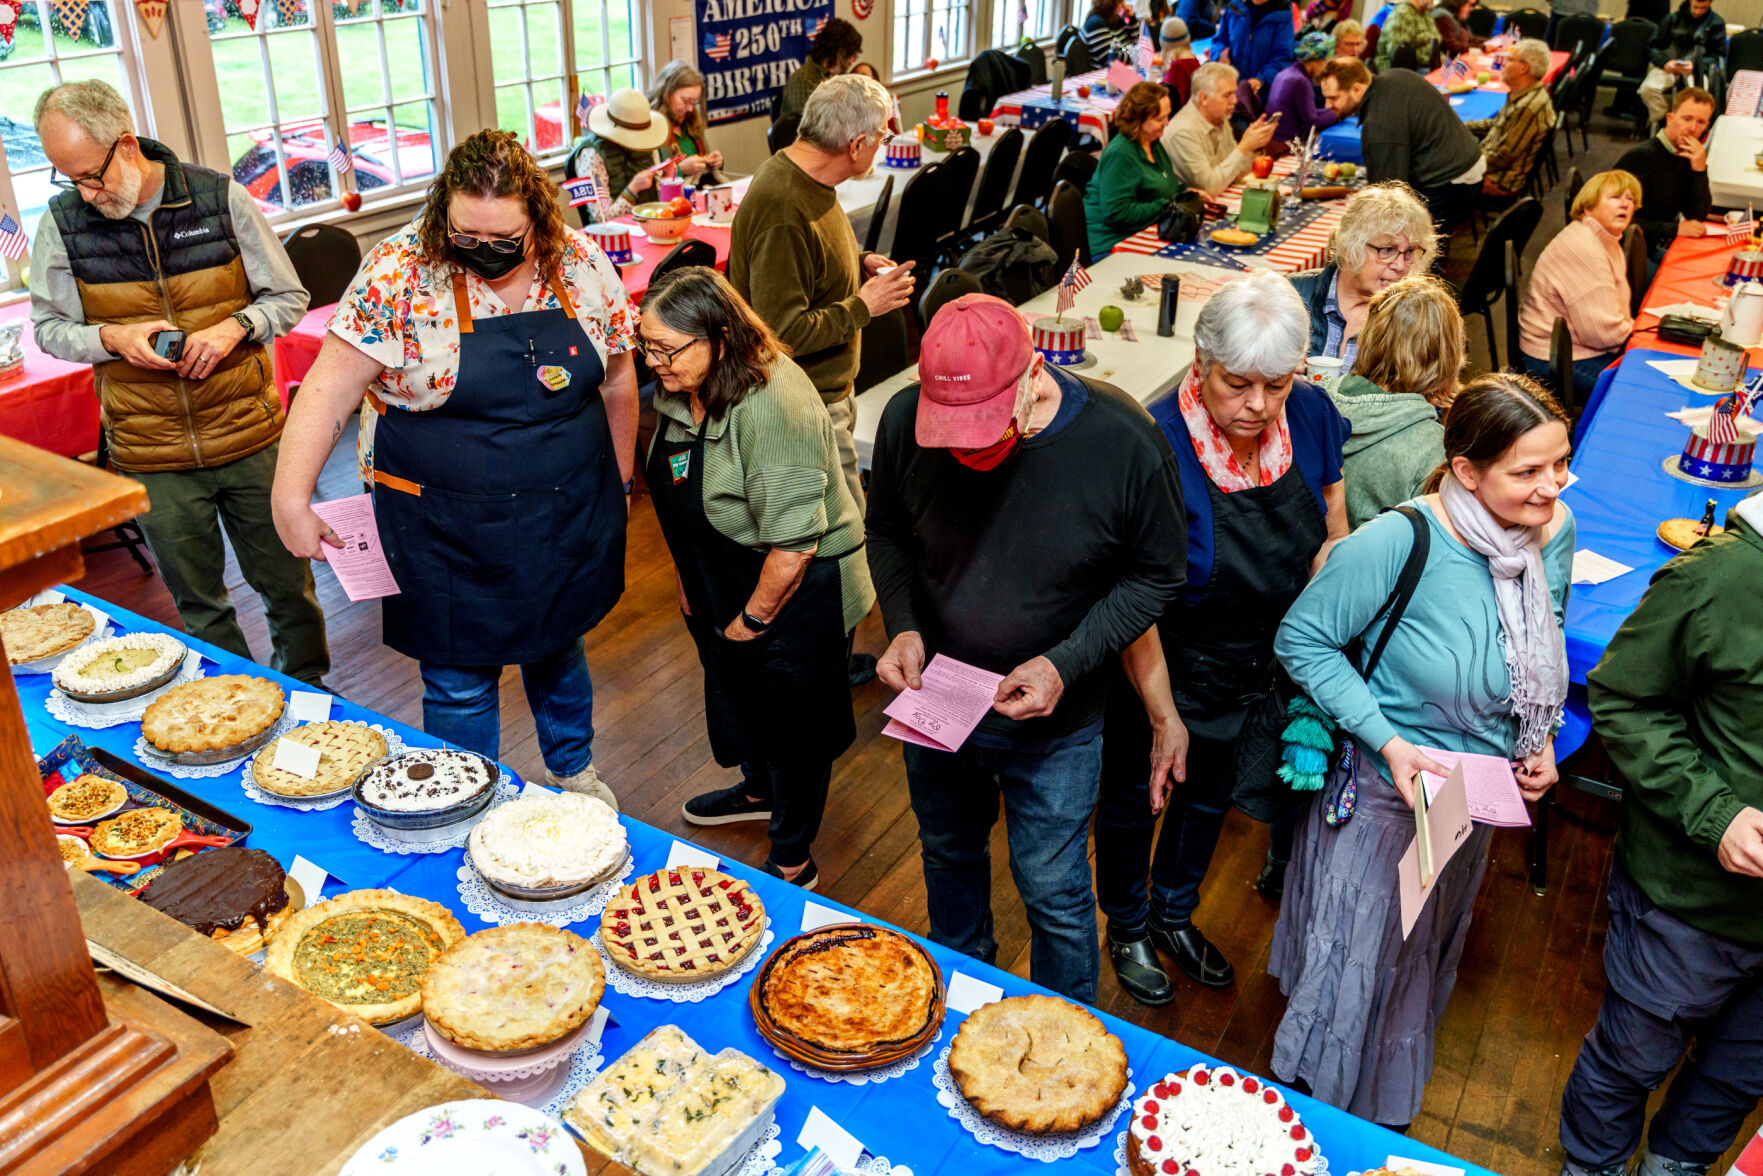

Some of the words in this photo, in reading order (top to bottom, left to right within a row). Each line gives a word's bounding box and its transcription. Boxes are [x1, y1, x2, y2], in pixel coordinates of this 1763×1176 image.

[735, 18, 802, 59] 250TH
[181, 226, 210, 238] Columbia
[953, 374, 971, 382] VIBES
